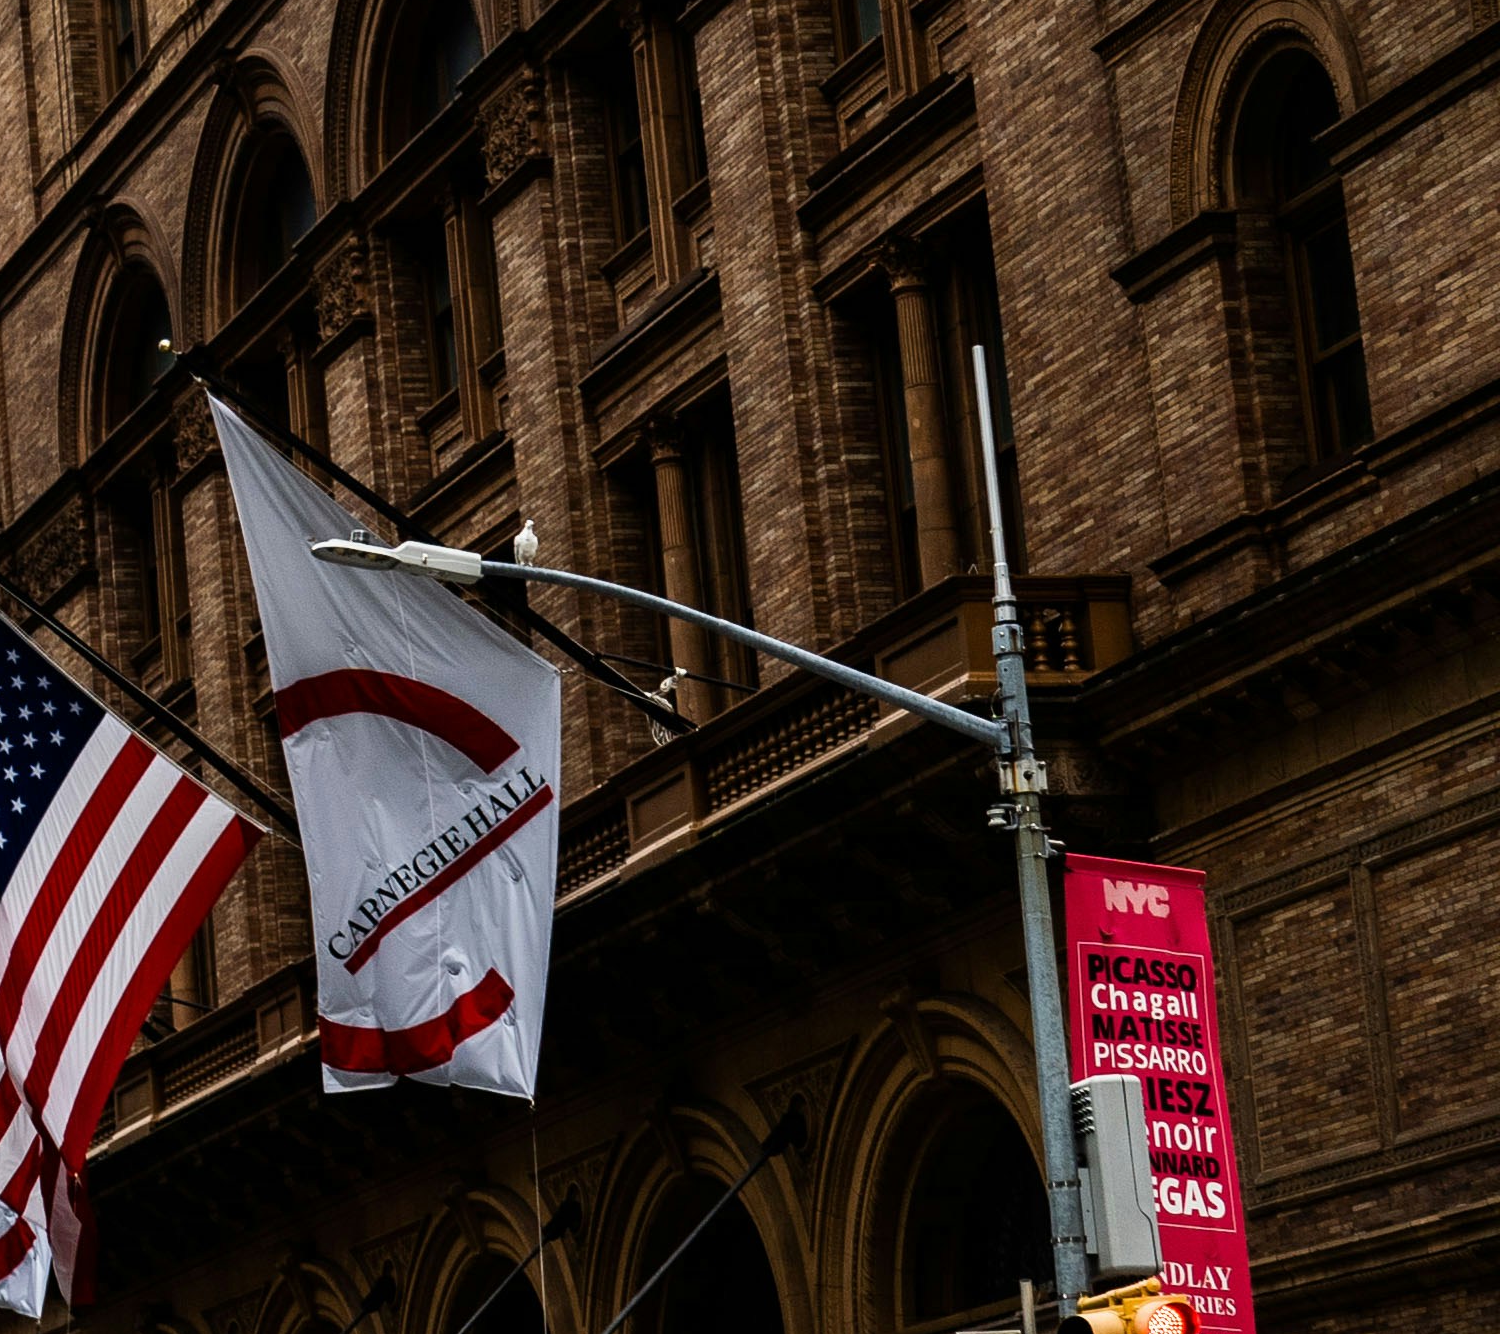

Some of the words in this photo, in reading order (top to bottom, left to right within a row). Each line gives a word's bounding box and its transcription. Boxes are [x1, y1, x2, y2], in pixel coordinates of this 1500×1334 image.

[328, 825, 470, 960] CARNEGIE
[461, 766, 547, 840] HALL
[1103, 878, 1170, 918] NYC
[1088, 954, 1197, 992] PICASSO
[1091, 983, 1198, 1020] Chagall
[1092, 1014, 1203, 1049] MATISSE
[1093, 1042, 1207, 1076] PISSARRO
[1144, 1077, 1215, 1117] IESZ
[1145, 1117, 1217, 1153] noir
[1150, 1151, 1220, 1179] NNARD
[1151, 1176, 1226, 1219] EGAS
[1159, 1261, 1233, 1291] NDLAY
